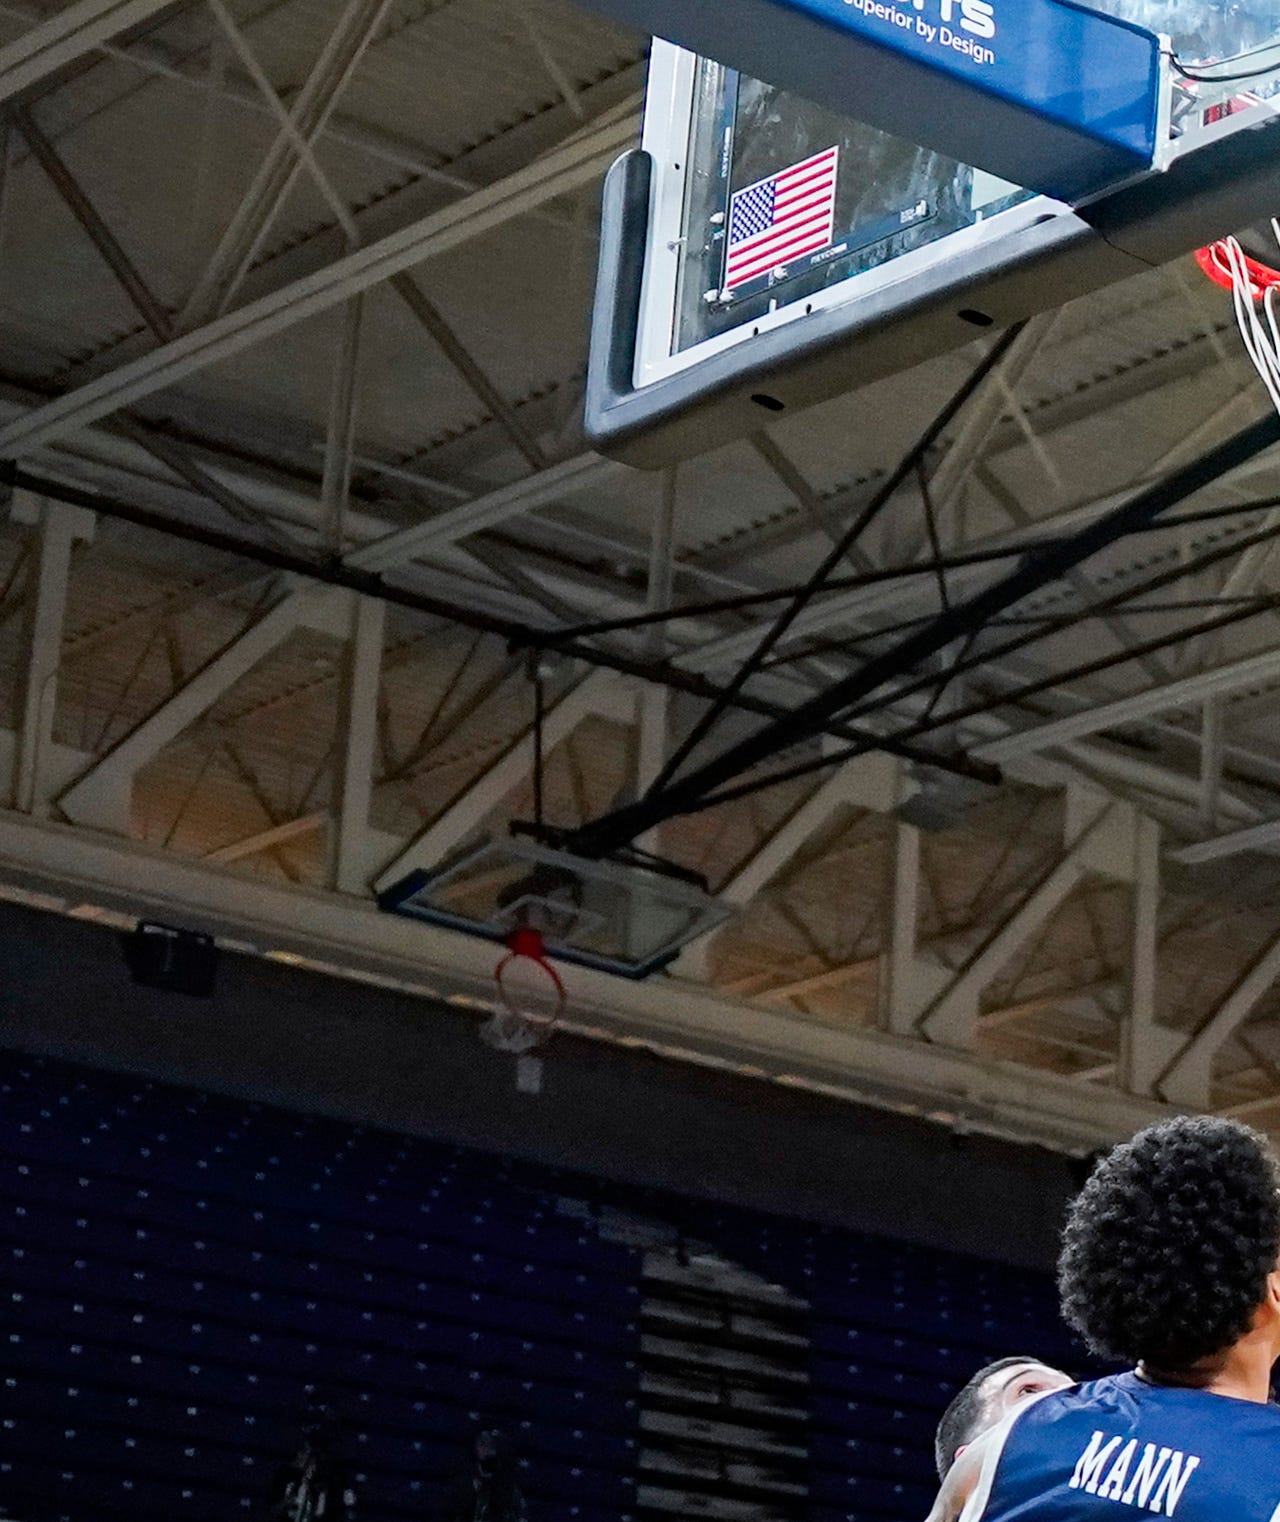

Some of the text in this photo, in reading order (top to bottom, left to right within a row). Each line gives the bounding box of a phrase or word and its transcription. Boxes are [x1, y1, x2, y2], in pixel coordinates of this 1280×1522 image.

[843, 0, 995, 64] uperior by Design
[1069, 1431, 1200, 1517] MANN
